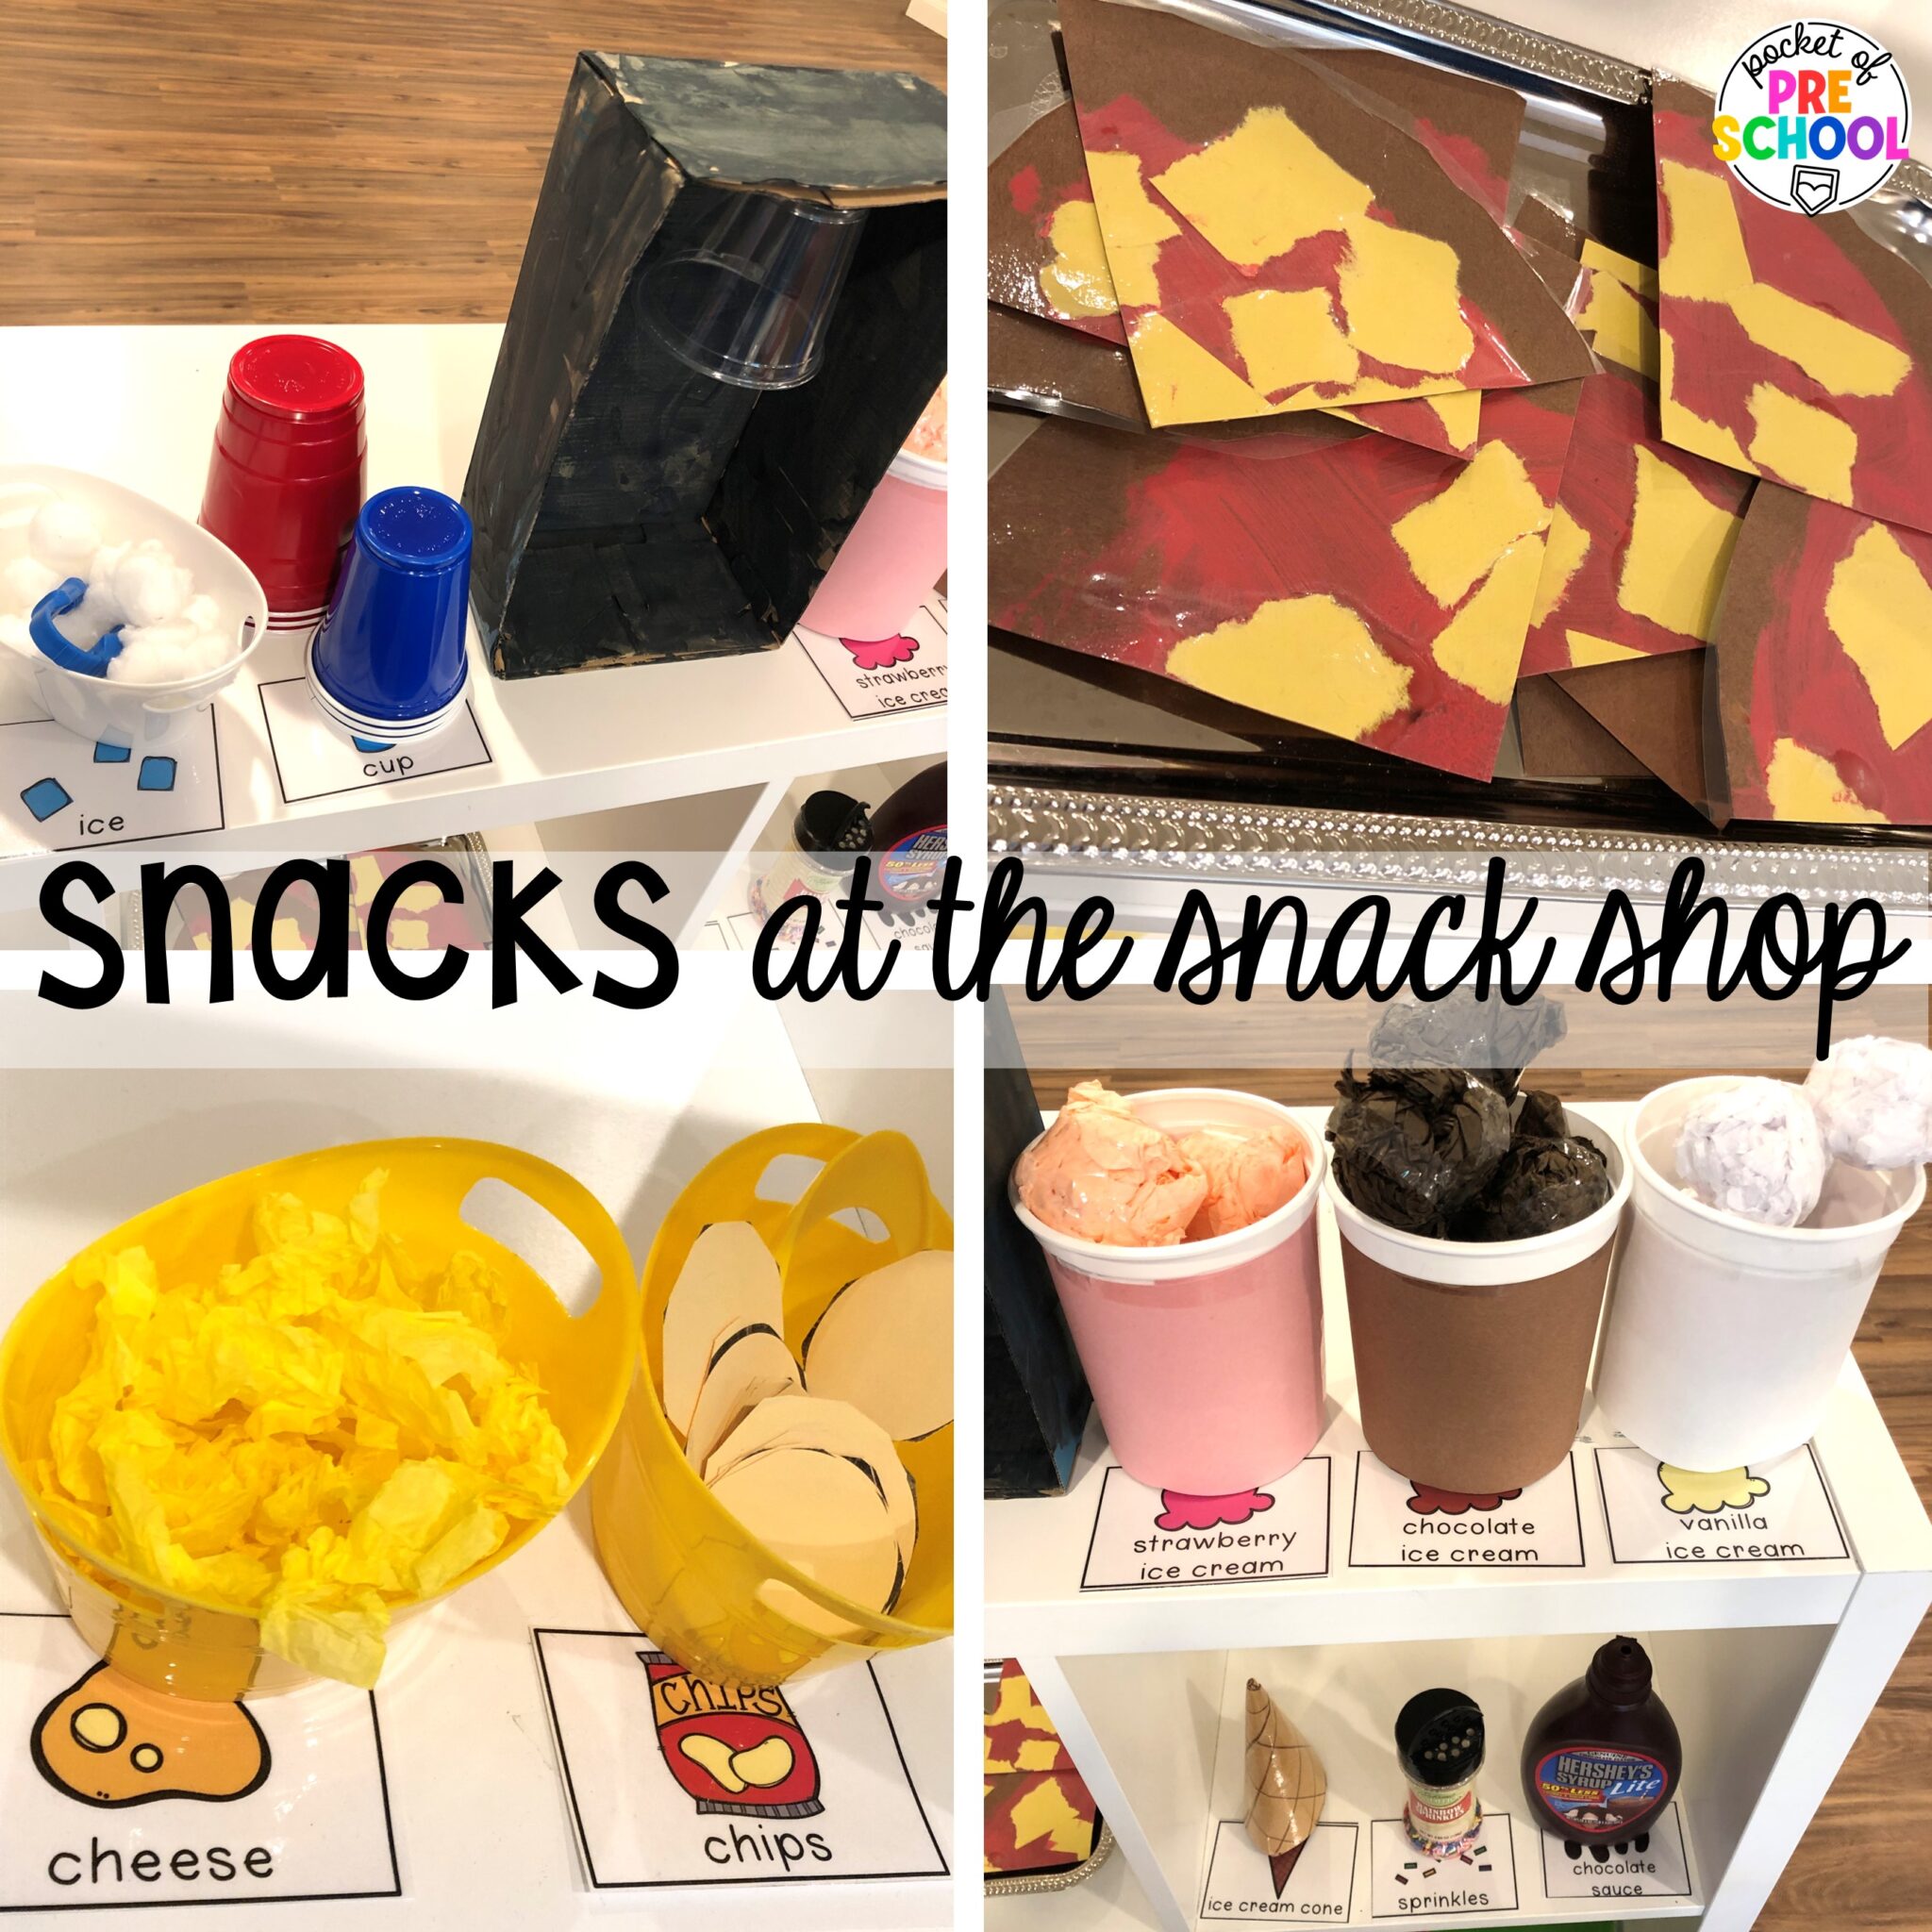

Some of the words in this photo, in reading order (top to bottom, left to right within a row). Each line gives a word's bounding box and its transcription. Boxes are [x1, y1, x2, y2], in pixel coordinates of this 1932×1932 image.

[875, 693, 907, 708] ice
[362, 755, 414, 777] cup
[78, 814, 125, 836] ice
[893, 921, 937, 940] chocol
[1403, 1517, 1536, 1535] chocolate
[1679, 1513, 1769, 1531] vanilla
[1133, 1531, 1297, 1554] strawberry
[1401, 1543, 1441, 1562] ice
[1450, 1548, 1539, 1562] cream
[1665, 1541, 1707, 1559] ice
[1715, 1542, 1806, 1558] cream
[1140, 1562, 1181, 1580] ice
[1191, 1559, 1284, 1578] cream
[1557, 1755, 1654, 1780] HERSHEY'S
[1557, 1772, 1612, 1790] SYRUP
[1609, 1779, 1661, 1795] Lite
[704, 1824, 833, 1873] chips
[47, 1836, 274, 1887] cheese
[1573, 1860, 1656, 1875] chocolate
[1591, 1883, 1643, 1896] sauce
[1208, 1898, 1233, 1911] ice
[1239, 1901, 1295, 1915] cream
[1300, 1903, 1343, 1916] cone
[1397, 1890, 1490, 1913] sprinkles
